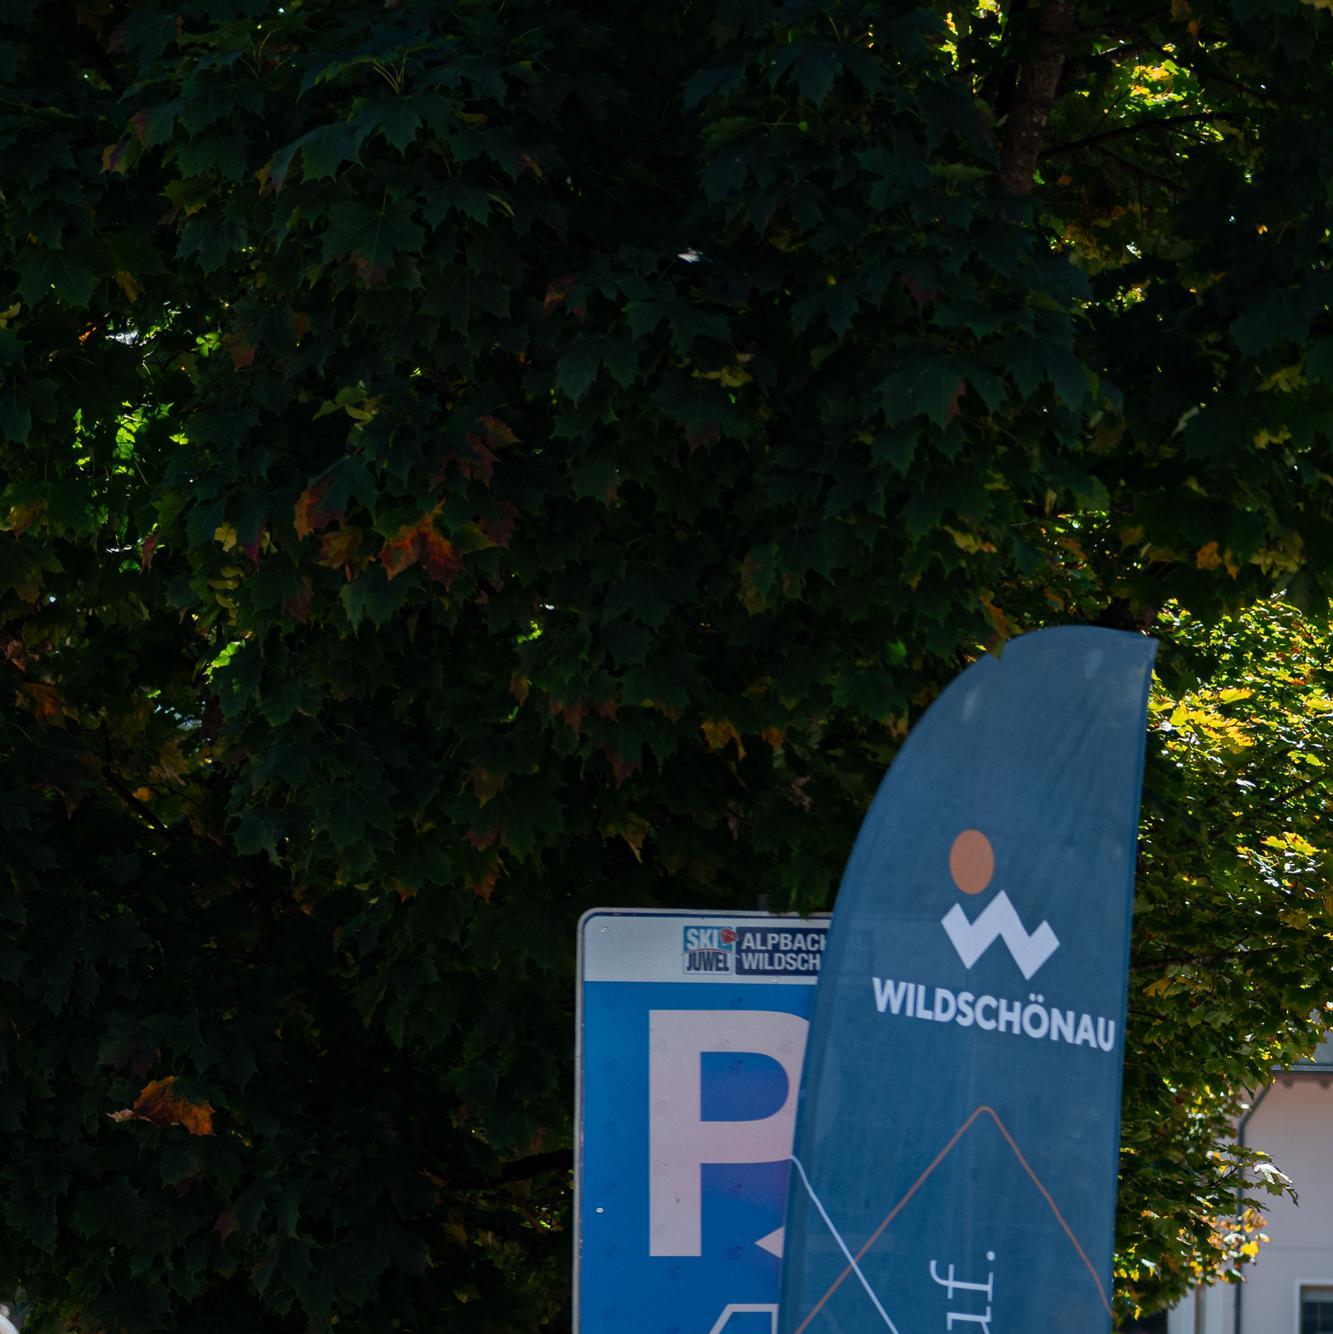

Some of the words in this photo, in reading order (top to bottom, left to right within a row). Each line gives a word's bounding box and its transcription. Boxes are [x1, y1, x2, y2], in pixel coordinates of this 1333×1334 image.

[686, 928, 719, 950] SKI
[686, 951, 730, 972] JUWEL
[872, 977, 1116, 1052] WILDSCHÖNAU
[648, 1009, 808, 1258] P
